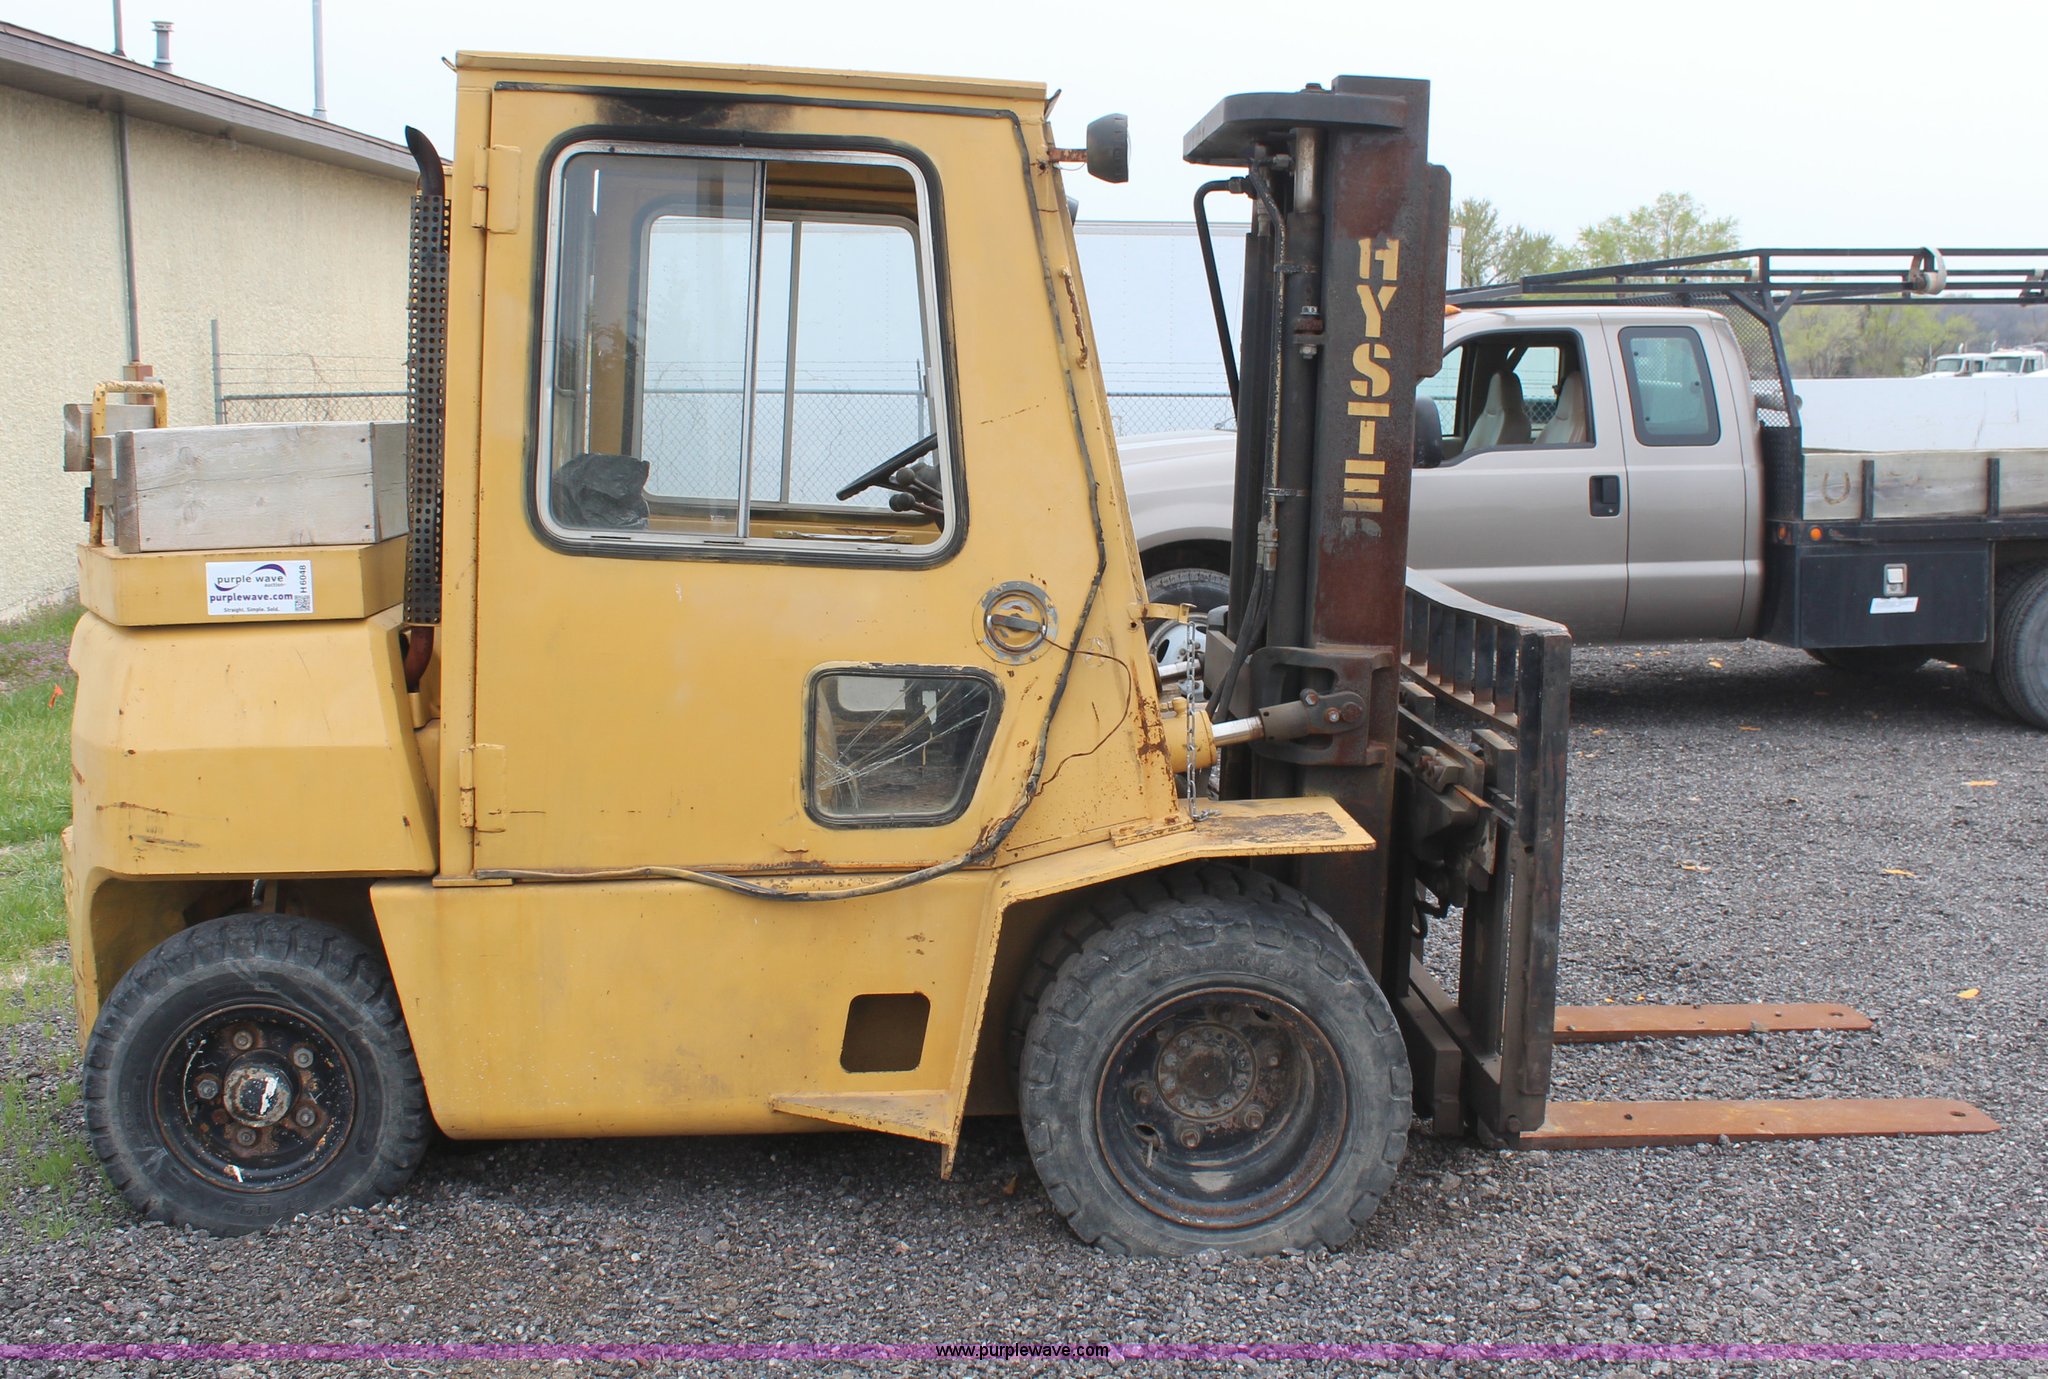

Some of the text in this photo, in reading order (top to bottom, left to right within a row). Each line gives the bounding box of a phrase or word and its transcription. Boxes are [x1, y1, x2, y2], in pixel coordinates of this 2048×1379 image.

[217, 575, 284, 584] purple wave
[210, 593, 293, 603] purplewave.com
